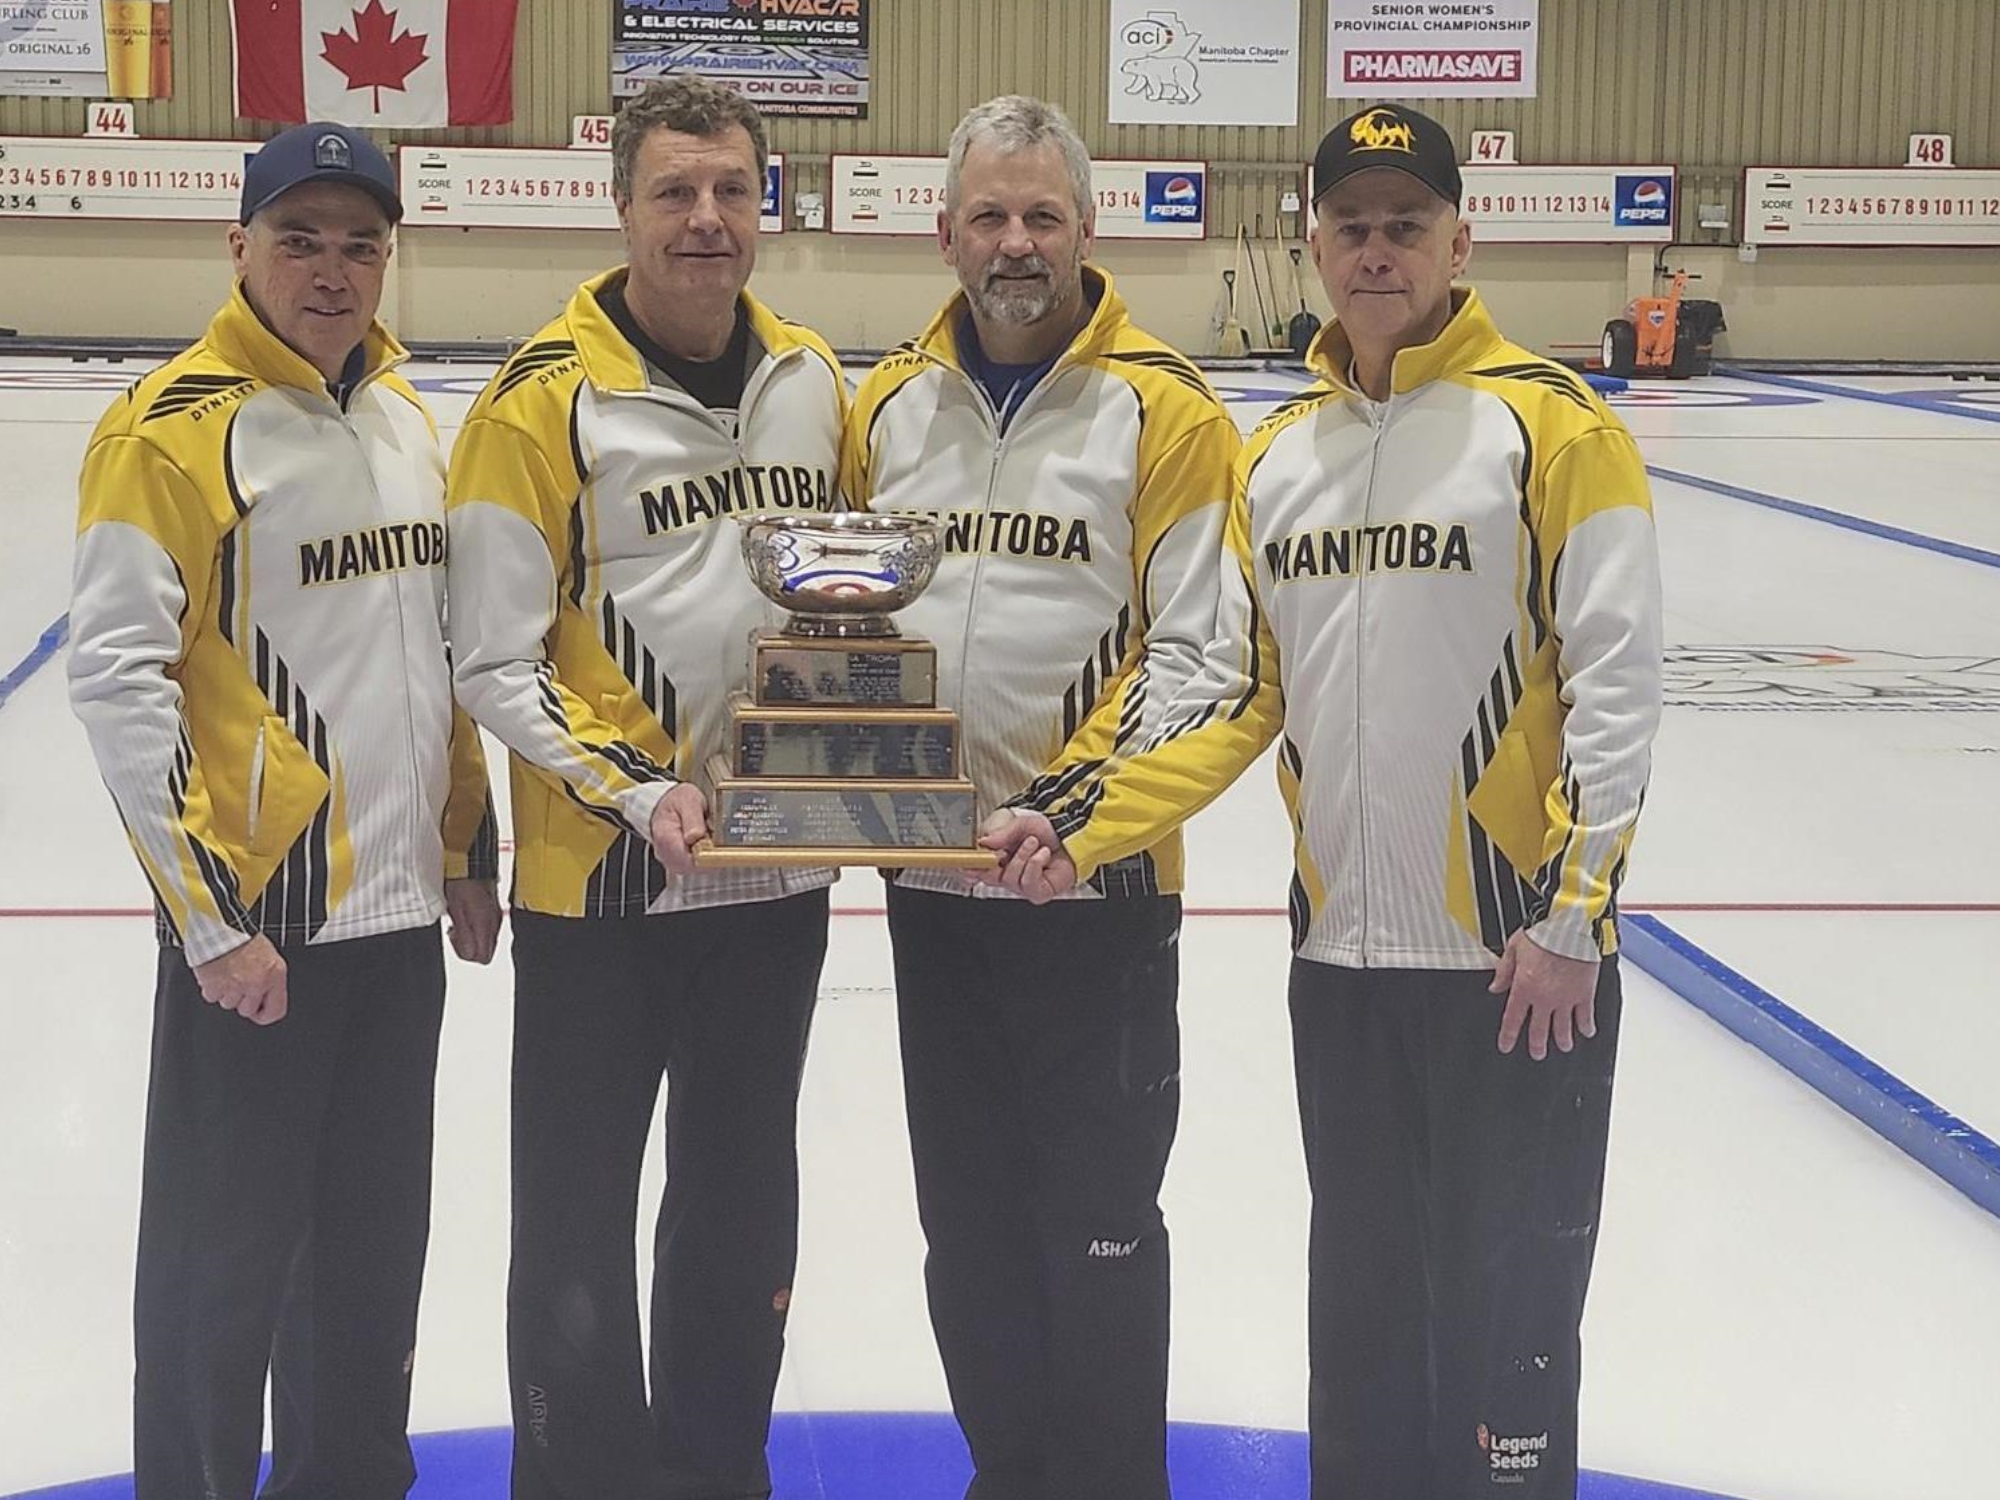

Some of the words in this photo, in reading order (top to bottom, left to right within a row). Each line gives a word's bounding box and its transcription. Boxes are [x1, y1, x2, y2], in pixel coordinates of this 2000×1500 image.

[1, 7, 48, 19] RLING
[51, 8, 89, 20] CLUB
[760, 0, 860, 16] HVAC/R
[1371, 4, 1424, 15] SENIOR
[1428, 4, 1494, 16] WOMEN'S
[624, 14, 638, 28] &
[641, 15, 759, 31] ELECTRICAL
[762, 18, 860, 34] SERVICES
[1334, 20, 1419, 31] PROVINCIAL
[1423, 20, 1532, 31] CHAMPIONSHIP
[1127, 28, 1160, 45] aci
[8, 43, 74, 55] ORIGINAL
[77, 42, 91, 55] 16
[1199, 46, 1246, 56] Manitoba
[1248, 47, 1290, 57] Chapter
[1350, 54, 1516, 79] PHARMASAVE
[746, 81, 775, 94] ON
[780, 82, 824, 95] OUR
[829, 84, 859, 95] ICE
[96, 107, 126, 133] 44
[580, 118, 611, 144] 45
[1477, 135, 1507, 160] 47
[1915, 138, 1945, 163] 48
[10, 168, 20, 185] 3
[25, 168, 35, 186] 4
[41, 169, 50, 186] 5
[56, 169, 66, 186] 6
[71, 169, 81, 187] 7
[87, 170, 97, 187] 8
[102, 170, 112, 187] 9
[119, 170, 138, 188] 10
[144, 171, 162, 188] 11
[171, 171, 189, 189] 12
[196, 172, 214, 189] 13
[221, 173, 240, 190] 14
[418, 179, 452, 189] SCORE
[467, 179, 473, 195] 1
[480, 179, 490, 195] 2
[495, 179, 505, 196] 3
[510, 180, 520, 196] 4
[525, 180, 535, 197] 5
[540, 180, 550, 197] 6
[554, 180, 565, 197] 7
[570, 181, 580, 198] 8
[585, 181, 595, 198] 9
[849, 188, 882, 198] SCORE
[895, 188, 902, 204] 1
[908, 188, 918, 204] 2
[923, 188, 933, 204] 3
[10, 195, 20, 209] 3
[25, 194, 36, 209] 4
[71, 196, 82, 211] 6
[1098, 190, 1117, 208] 13
[1122, 191, 1141, 208] 14
[1467, 196, 1478, 212] 8
[1482, 196, 1492, 212] 9
[1497, 196, 1516, 213] 10
[1521, 196, 1538, 213] 11
[1545, 197, 1563, 213] 12
[1569, 197, 1587, 213] 13
[1592, 197, 1611, 213] 14
[1761, 199, 1794, 210] SCORE
[1806, 197, 1814, 214] 1
[1820, 198, 1830, 215] 2
[1834, 198, 1844, 215] 3
[1848, 198, 1858, 215] 4
[1862, 198, 1872, 215] 5
[1877, 198, 1887, 215] 6
[1890, 198, 1900, 215] 7
[1905, 198, 1915, 215] 8
[1919, 199, 1929, 215] 9
[1934, 199, 1952, 216] 10
[1957, 199, 1974, 216] 11
[1981, 199, 1999, 216] 12
[1150, 204, 1198, 217] PEPSI
[1619, 208, 1667, 220] PEPSI
[883, 356, 933, 371] DYNA
[537, 360, 582, 385] DYNA
[191, 383, 256, 421] DYNASTY
[639, 465, 831, 536] MANITOBA
[890, 511, 1091, 562] NITOBA
[300, 522, 447, 586] MANITOB
[1264, 522, 1473, 583] MANITOBA
[1490, 1431, 1548, 1454] Legend
[1490, 1452, 1539, 1469] Seeds
